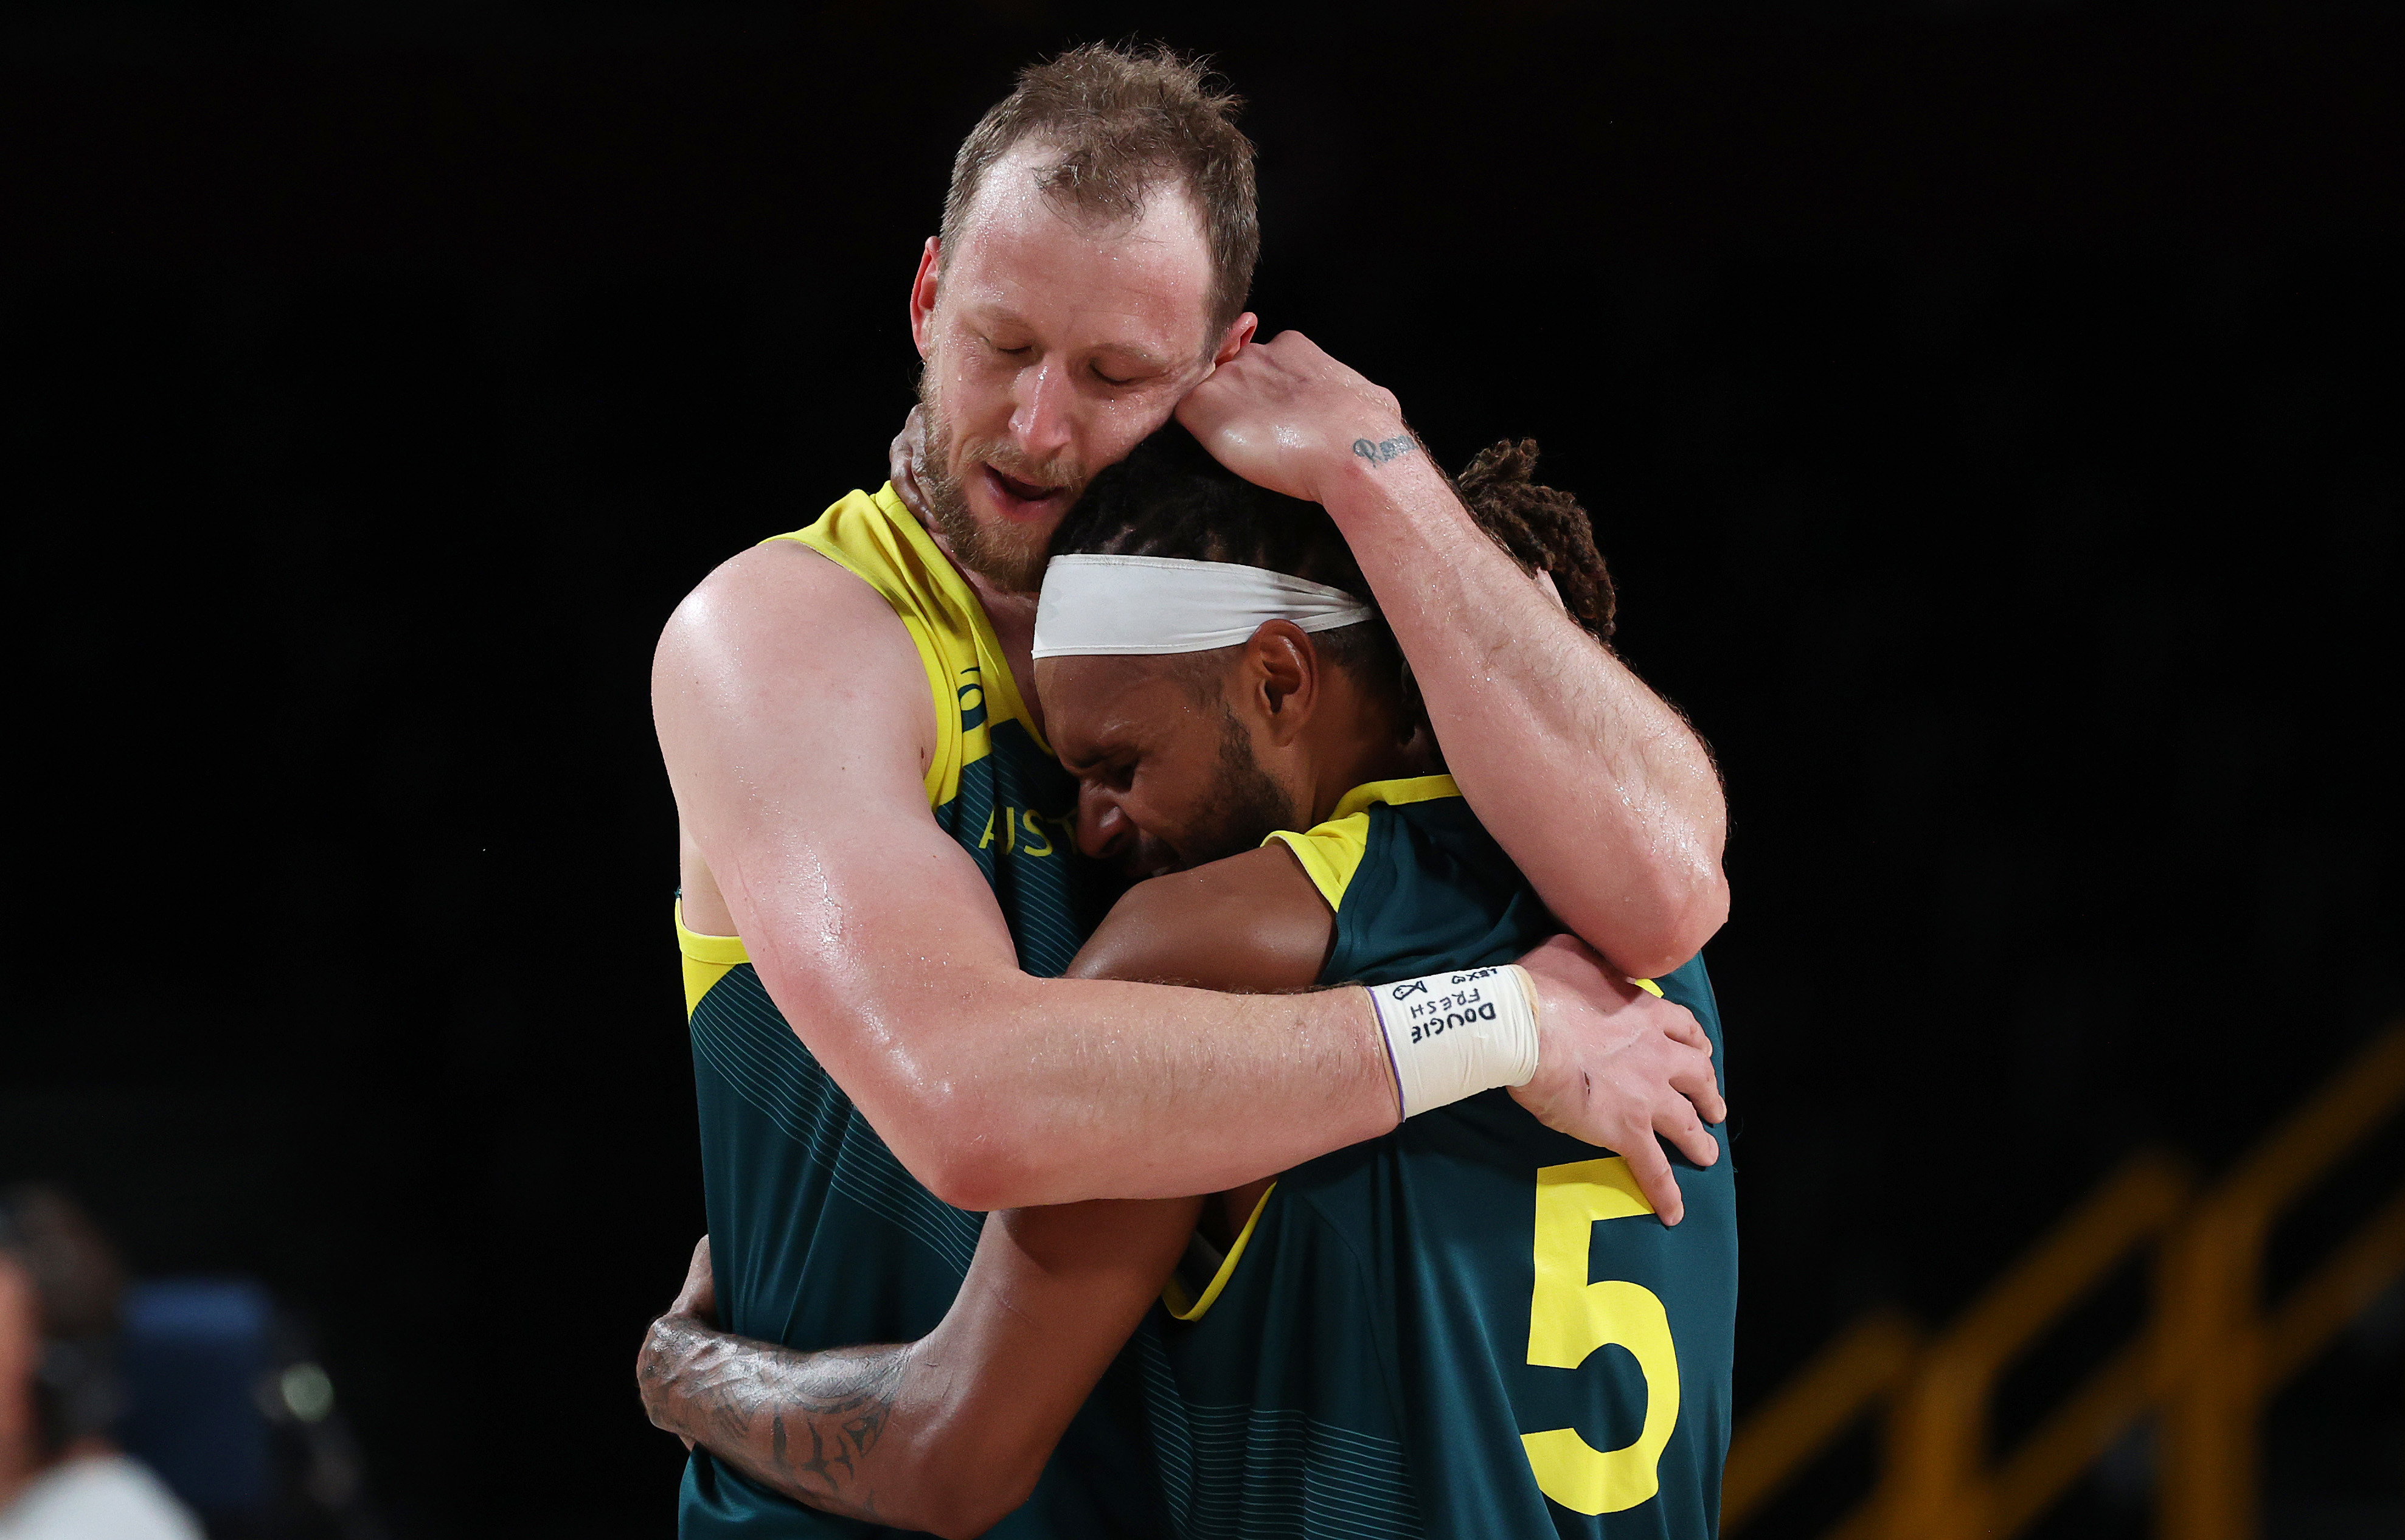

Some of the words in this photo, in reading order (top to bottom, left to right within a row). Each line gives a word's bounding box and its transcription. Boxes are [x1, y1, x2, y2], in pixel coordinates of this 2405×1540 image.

[1410, 988, 1480, 1019] FRESH
[1411, 1002, 1496, 1044] DOUGIE
[1521, 1156, 1680, 1516] 5
